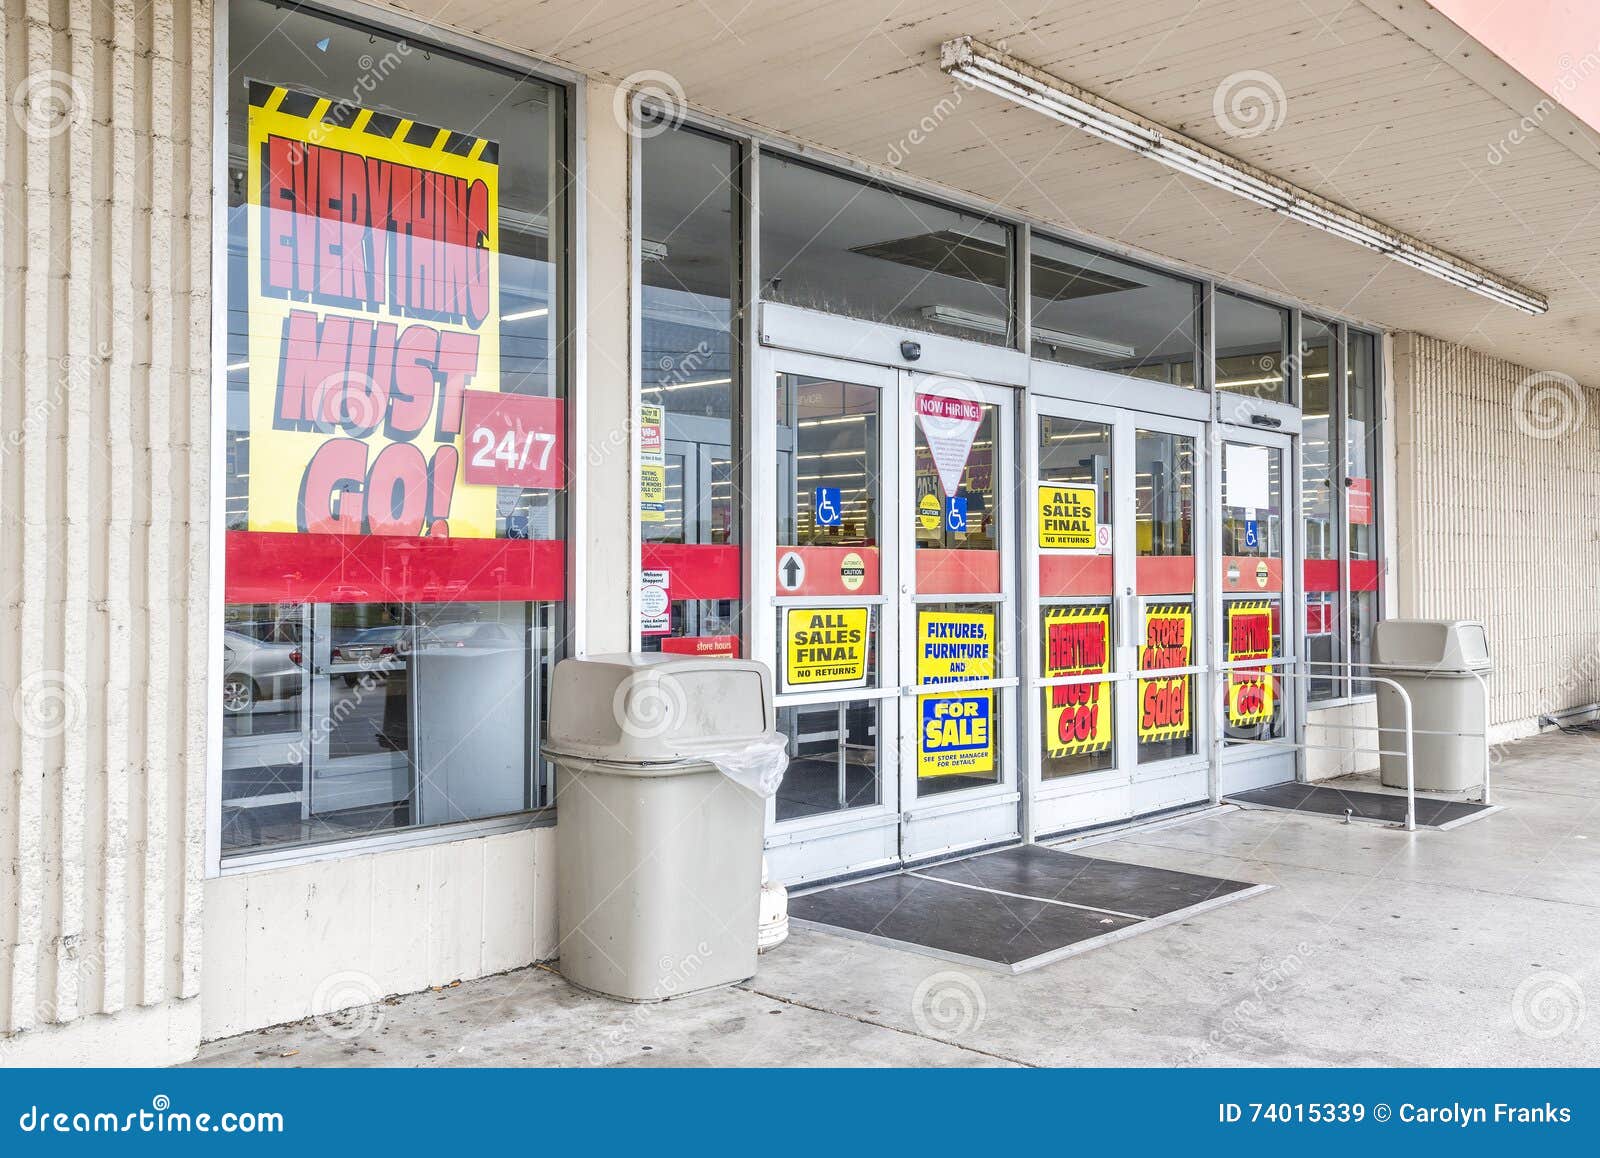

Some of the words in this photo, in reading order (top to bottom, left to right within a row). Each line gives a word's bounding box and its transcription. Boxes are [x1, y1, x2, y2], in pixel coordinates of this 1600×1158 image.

[260, 134, 490, 330] EVERYTHING
[272, 308, 481, 443] MUST
[920, 399, 944, 413] NOW
[945, 402, 980, 419] HIRING!
[642, 428, 656, 437] We
[472, 427, 556, 471] 24/7
[297, 437, 459, 537] GO!
[1053, 492, 1080, 504] ALL
[1043, 505, 1091, 518] SALES
[1044, 519, 1090, 532] FINAL
[810, 614, 847, 629] ALL
[795, 630, 861, 646] SALES
[927, 622, 987, 640] FIXTURES,
[1147, 618, 1185, 648] STORE
[696, 642, 713, 651] store
[714, 641, 732, 650] hours
[925, 643, 989, 659] FURNITURE
[1049, 620, 1106, 671] EVERYTHING
[796, 646, 858, 663] FINAL
[797, 669, 811, 678] NO
[815, 667, 857, 677] RETURNS
[950, 662, 966, 672] AND
[1142, 647, 1188, 682] CLOSING
[1052, 669, 1103, 709] MUST
[1142, 680, 1186, 730] Sale!
[1237, 684, 1265, 716] GO!
[935, 702, 979, 718] FOR
[1058, 704, 1099, 744] GO!
[926, 718, 987, 748] SALE
[923, 755, 934, 763] SEE
[959, 752, 989, 760] MANAGER
[951, 759, 976, 767] DETAILS
